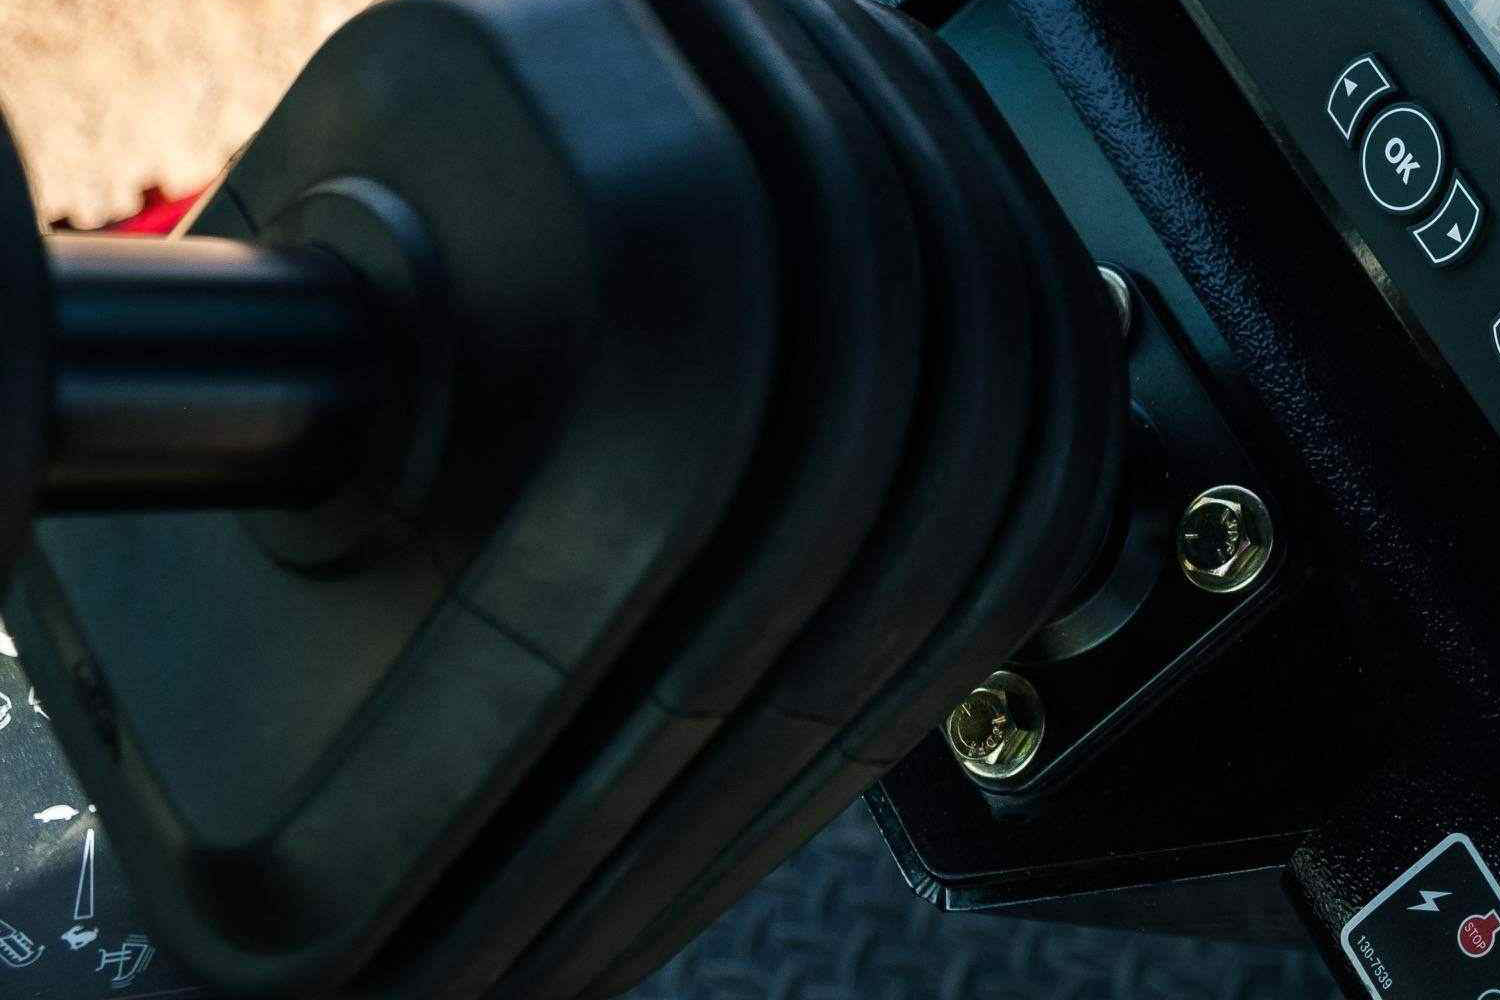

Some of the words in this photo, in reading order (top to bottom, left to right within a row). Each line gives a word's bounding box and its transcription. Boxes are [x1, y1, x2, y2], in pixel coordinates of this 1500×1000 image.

[1385, 137, 1420, 185] OK
[1464, 922, 1487, 951] STOP
[1356, 935, 1393, 991] 130-7539
